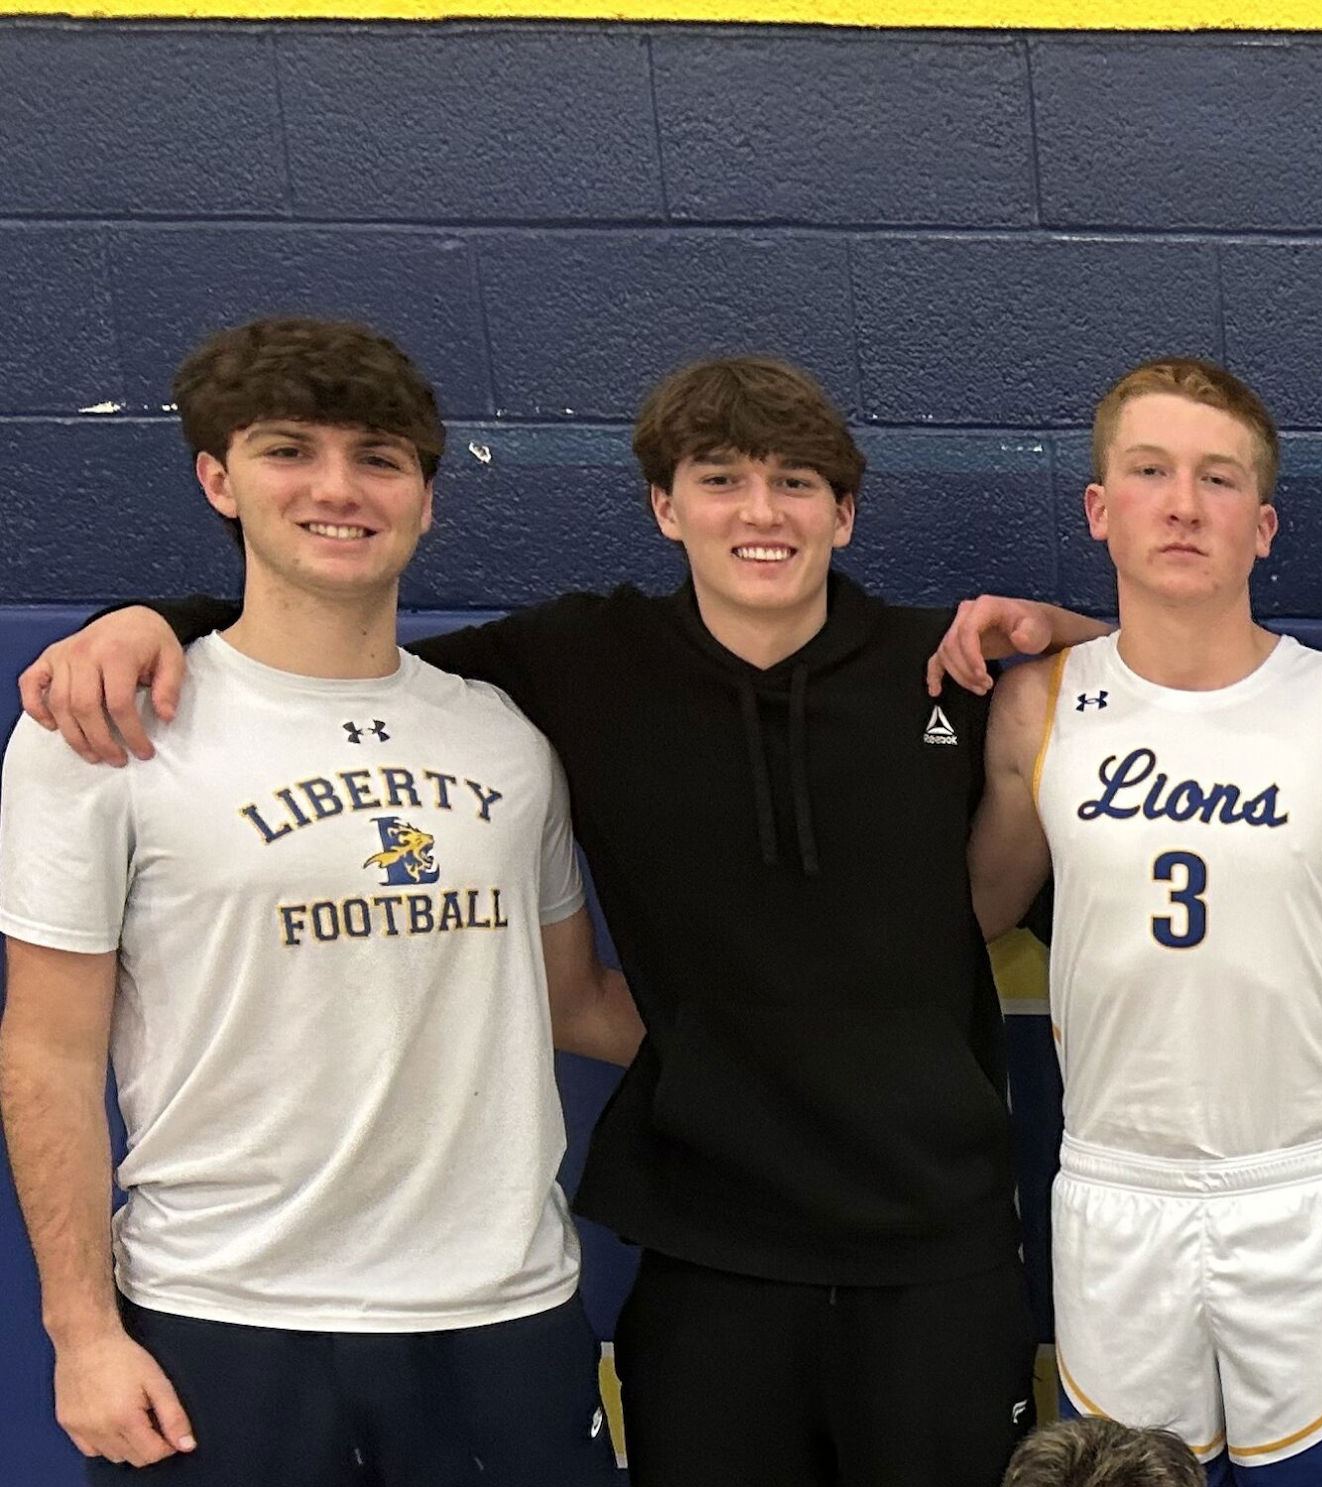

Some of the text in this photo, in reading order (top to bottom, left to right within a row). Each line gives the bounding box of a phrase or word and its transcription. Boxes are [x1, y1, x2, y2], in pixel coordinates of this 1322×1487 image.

[240, 766, 503, 846] LIBERTY
[1077, 748, 1288, 828] Lions
[279, 888, 508, 947] FOOTBALL
[1151, 850, 1208, 950] 3
